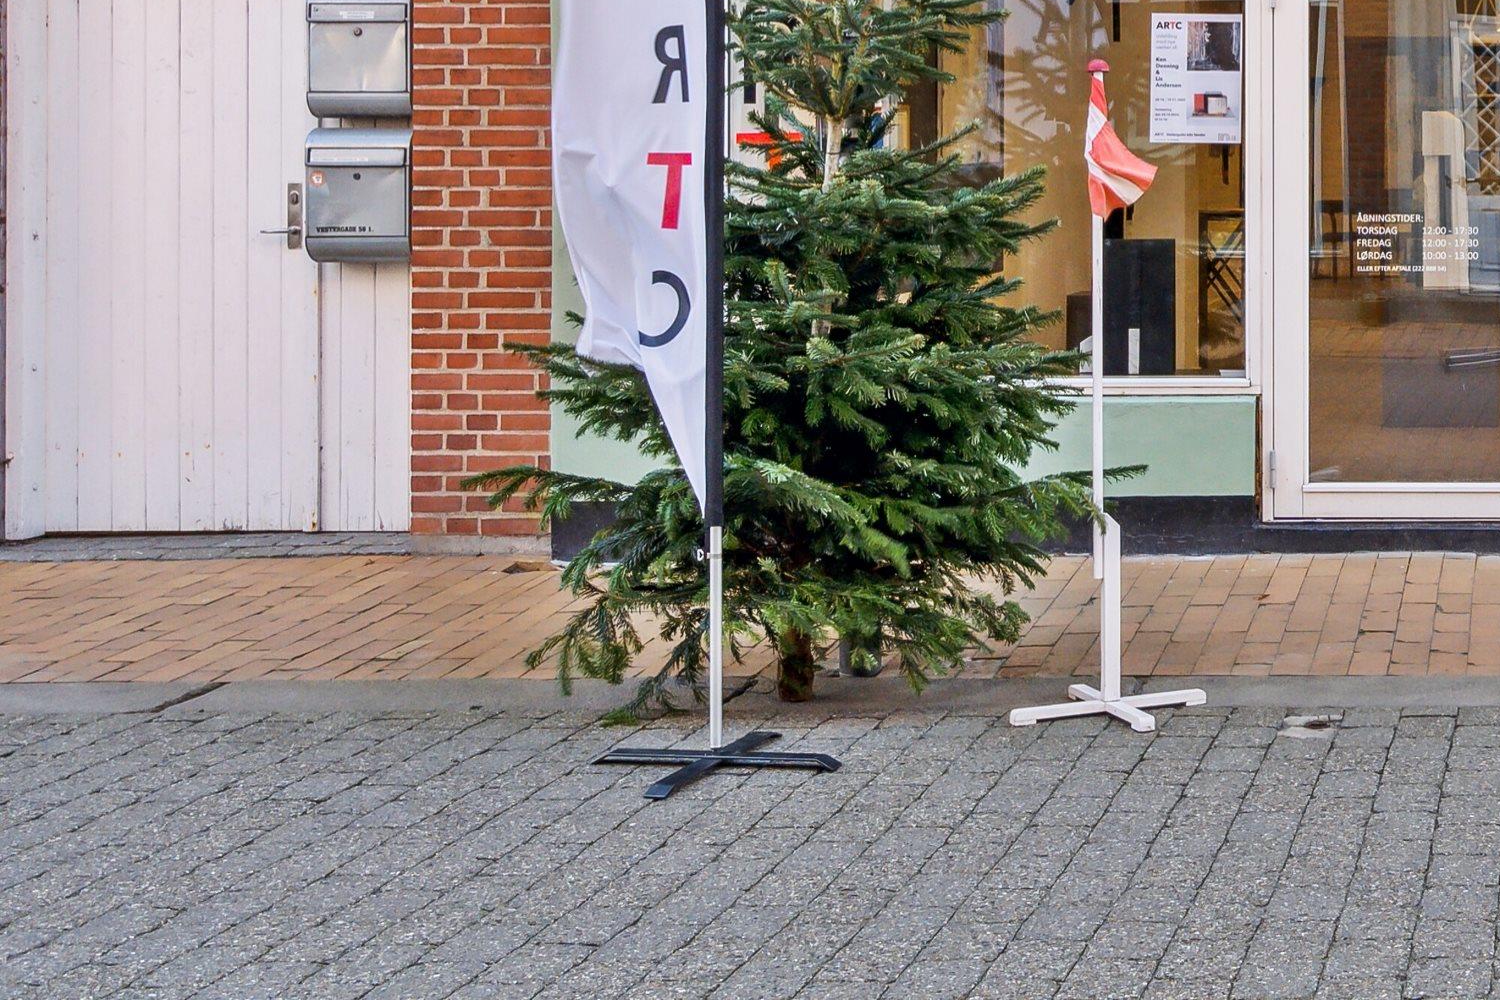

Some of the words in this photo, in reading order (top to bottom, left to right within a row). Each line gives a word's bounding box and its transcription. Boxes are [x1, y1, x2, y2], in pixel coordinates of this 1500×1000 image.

[1156, 21, 1182, 30] ARTC
[1356, 212, 1424, 223] ÅBNINGSTIDER:
[1356, 226, 1398, 235] TORSDAG
[1422, 226, 1447, 235] 12:00
[1454, 226, 1479, 235] 17:30
[1356, 239, 1392, 248] FREDAG
[1422, 239, 1447, 248] 12:00
[1454, 239, 1479, 248] 17:30
[1356, 250, 1393, 261] LØRDAG
[1422, 251, 1447, 260] 10:00
[1454, 251, 1479, 260] 13:00
